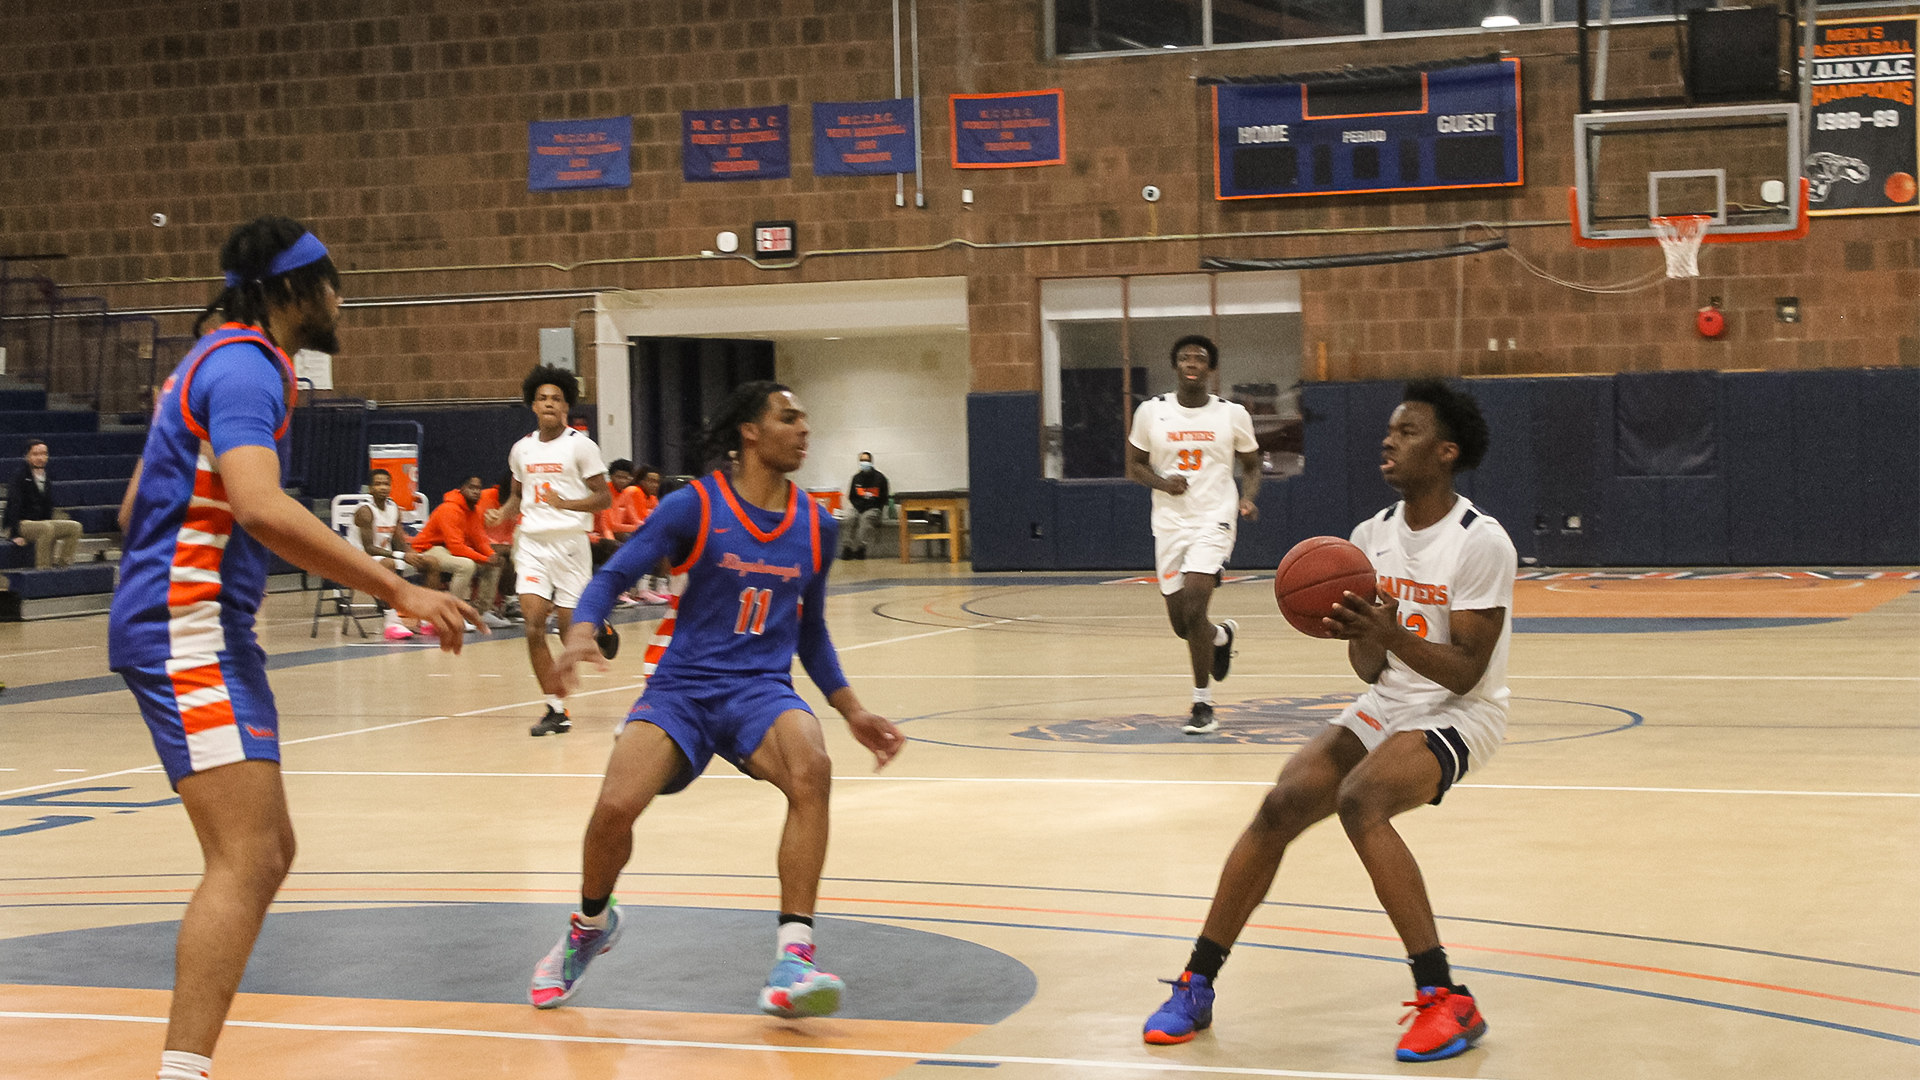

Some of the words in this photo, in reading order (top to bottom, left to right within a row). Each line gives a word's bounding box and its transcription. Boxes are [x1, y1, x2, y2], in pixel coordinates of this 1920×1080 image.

[1811, 80, 1914, 107] HAMPIONS
[1436, 113, 1496, 133] GUEST
[1238, 125, 1290, 144] HOME
[1342, 130, 1388, 143] PERIOD
[1178, 449, 1202, 471] 33
[734, 586, 773, 635] 11
